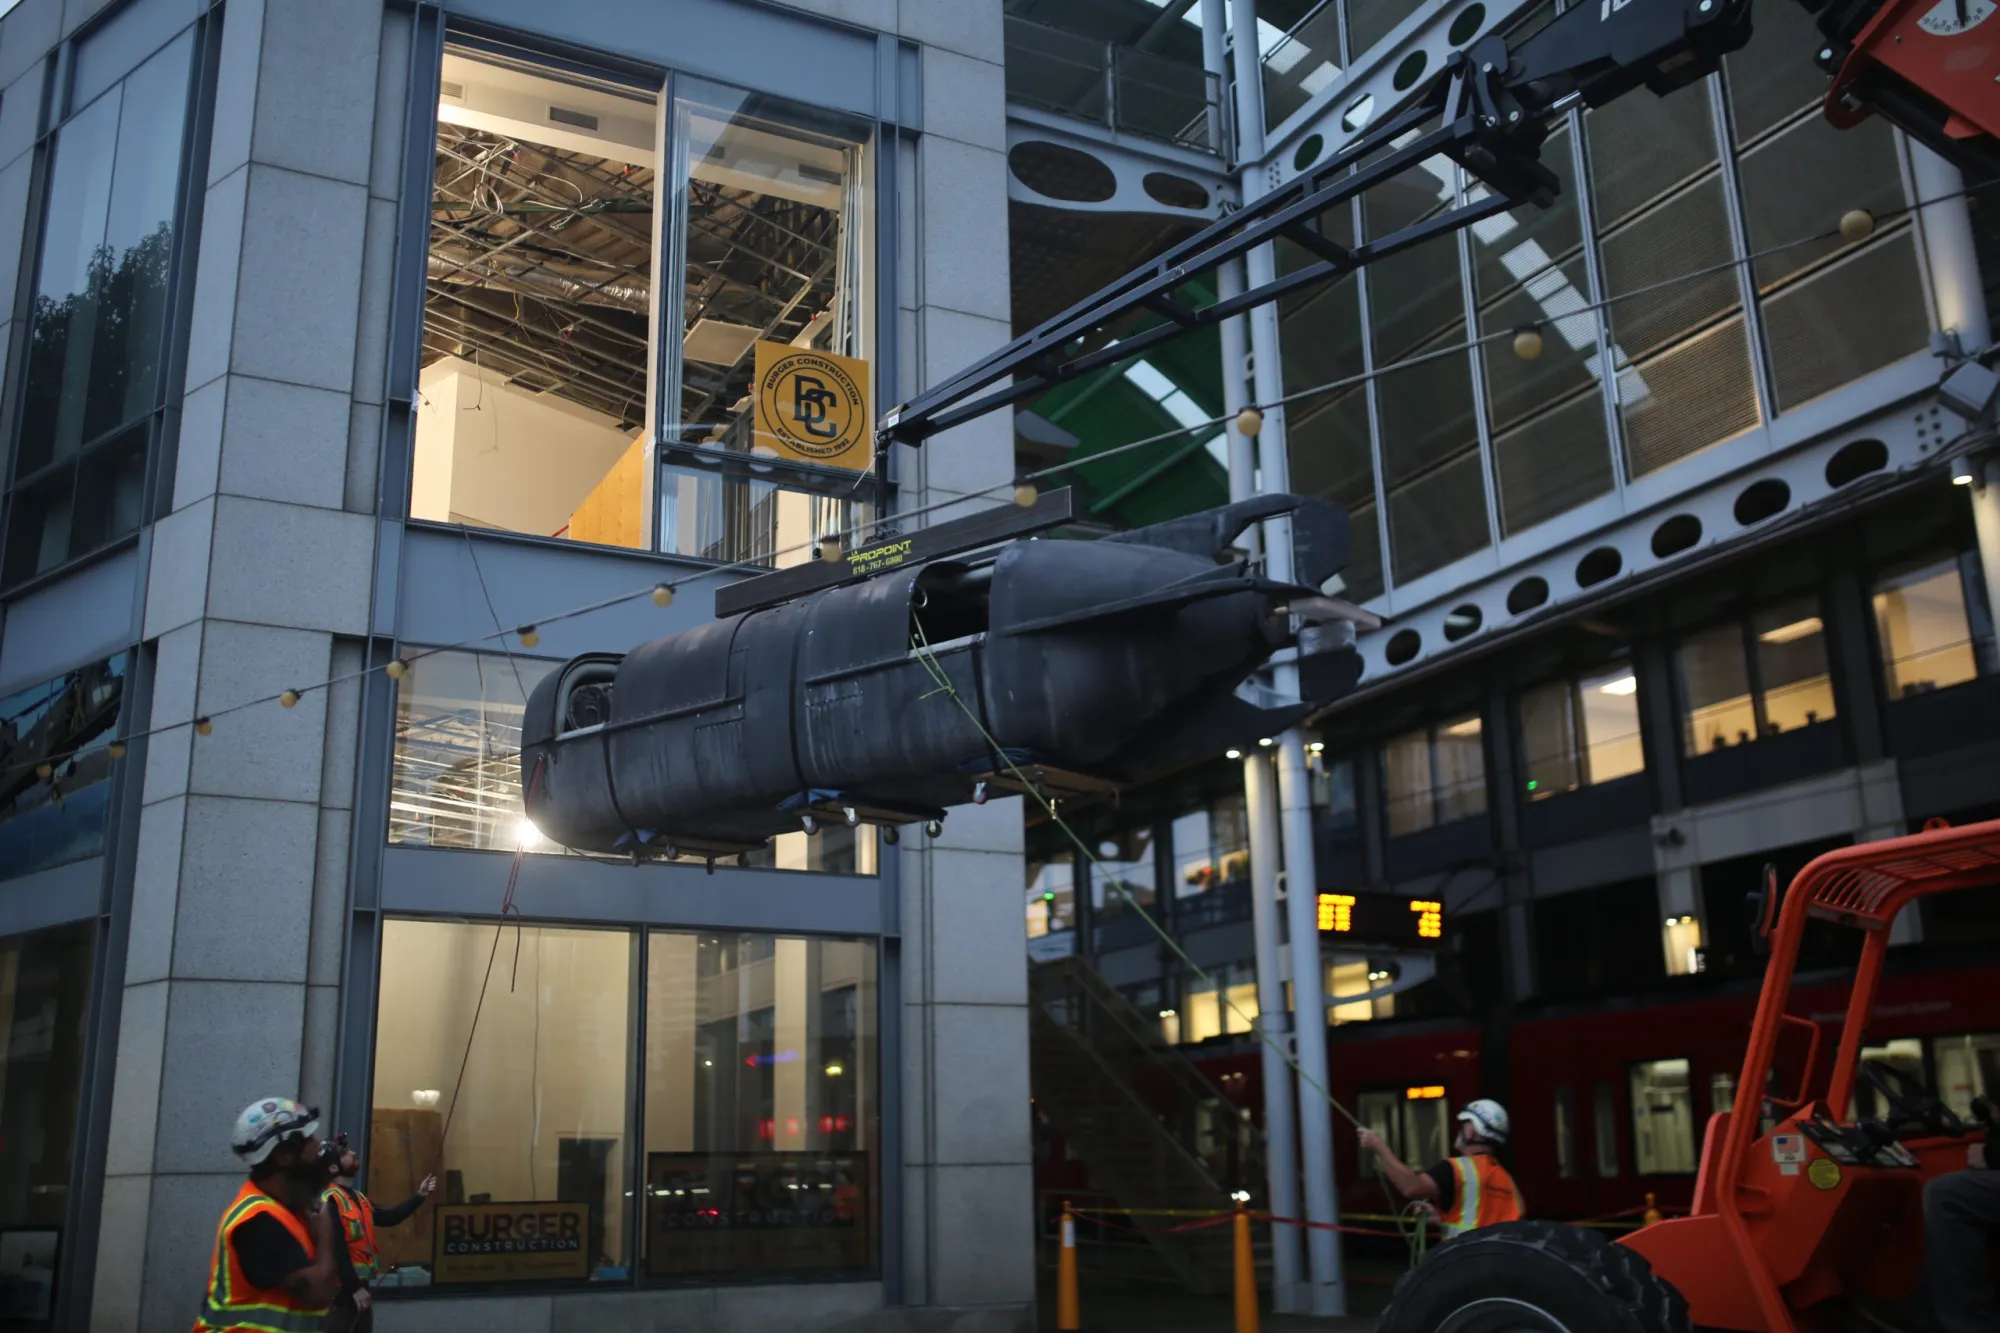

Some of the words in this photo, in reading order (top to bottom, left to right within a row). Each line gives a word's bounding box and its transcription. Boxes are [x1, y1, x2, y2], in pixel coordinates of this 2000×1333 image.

[766, 360, 795, 390] BURGER
[797, 358, 859, 406] CONSTRUCTION
[776, 427, 833, 454] ESTABLISHED
[847, 540, 912, 564] PROPOINT
[444, 1212, 580, 1240] BURGER
[667, 1210, 852, 1227] CONSTRUCTION
[446, 1239, 578, 1253] CONSTRUCTION
